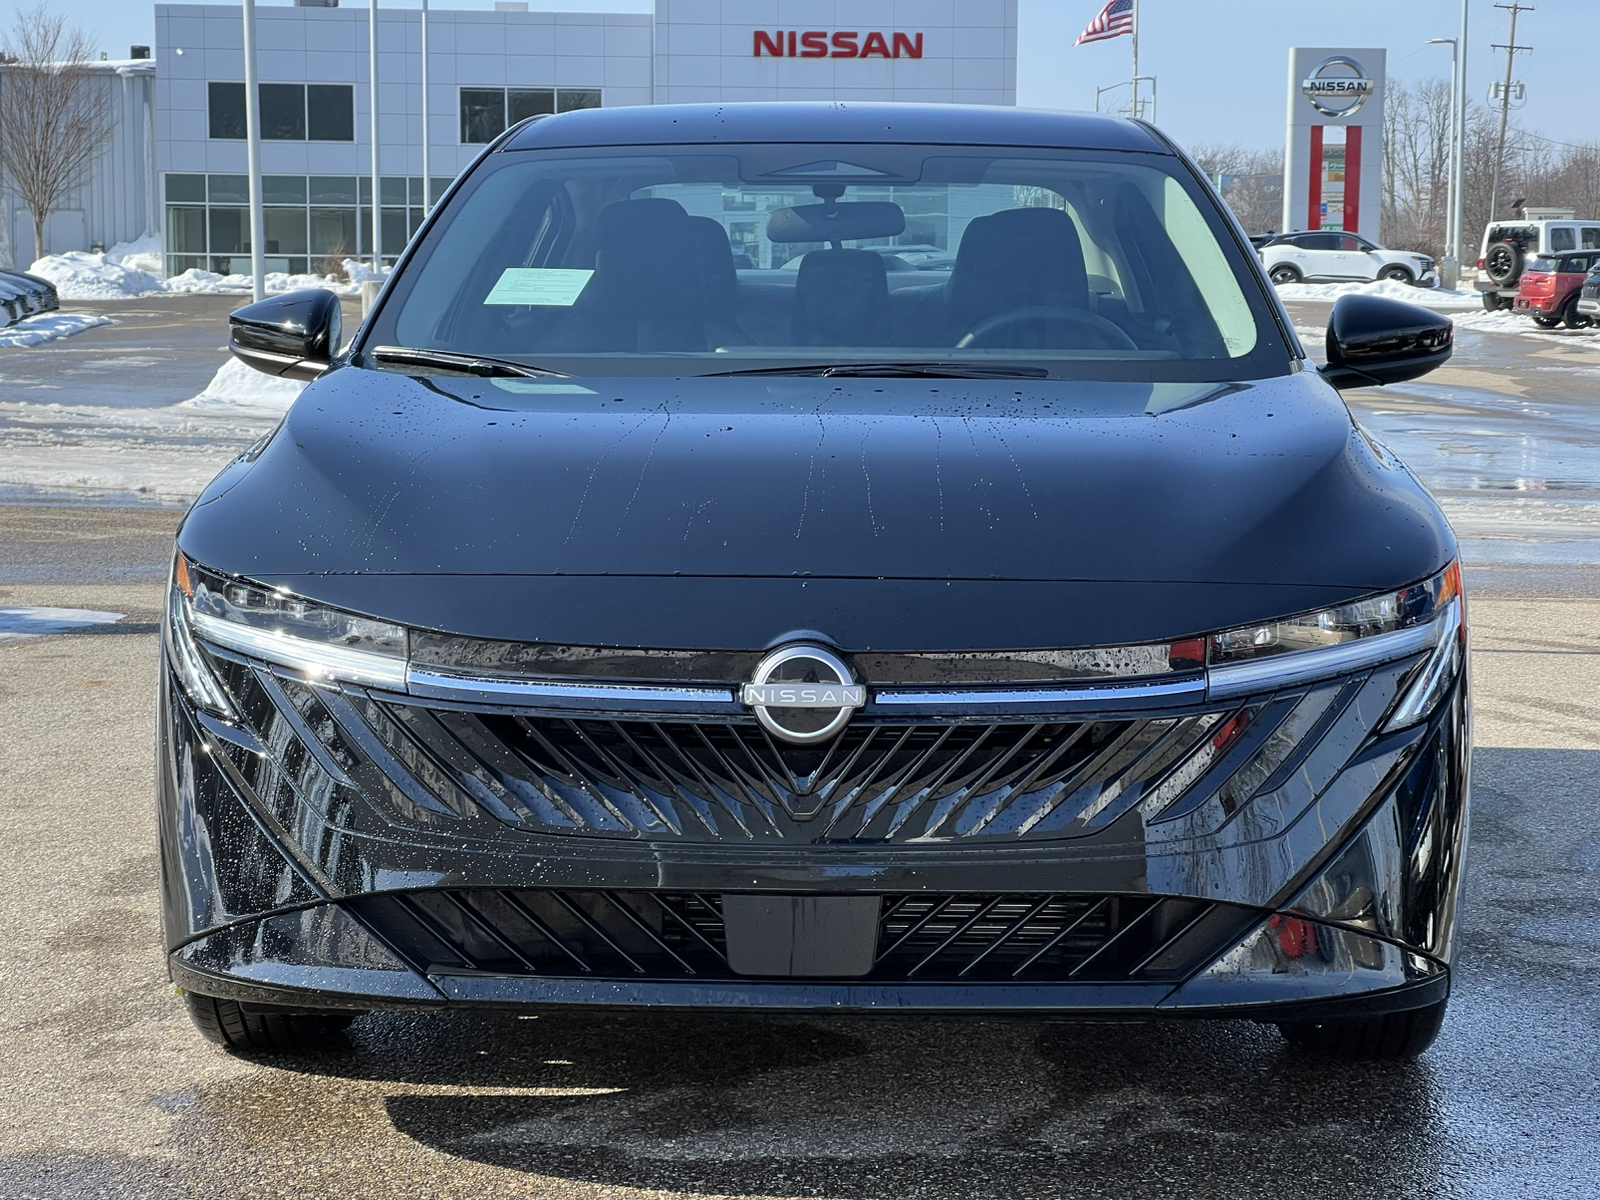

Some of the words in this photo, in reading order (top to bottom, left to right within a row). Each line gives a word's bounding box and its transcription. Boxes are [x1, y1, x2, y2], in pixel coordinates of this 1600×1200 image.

[754, 31, 923, 58] NISSAN
[1310, 82, 1367, 91] NISSAN
[749, 689, 859, 703] NISSAN
